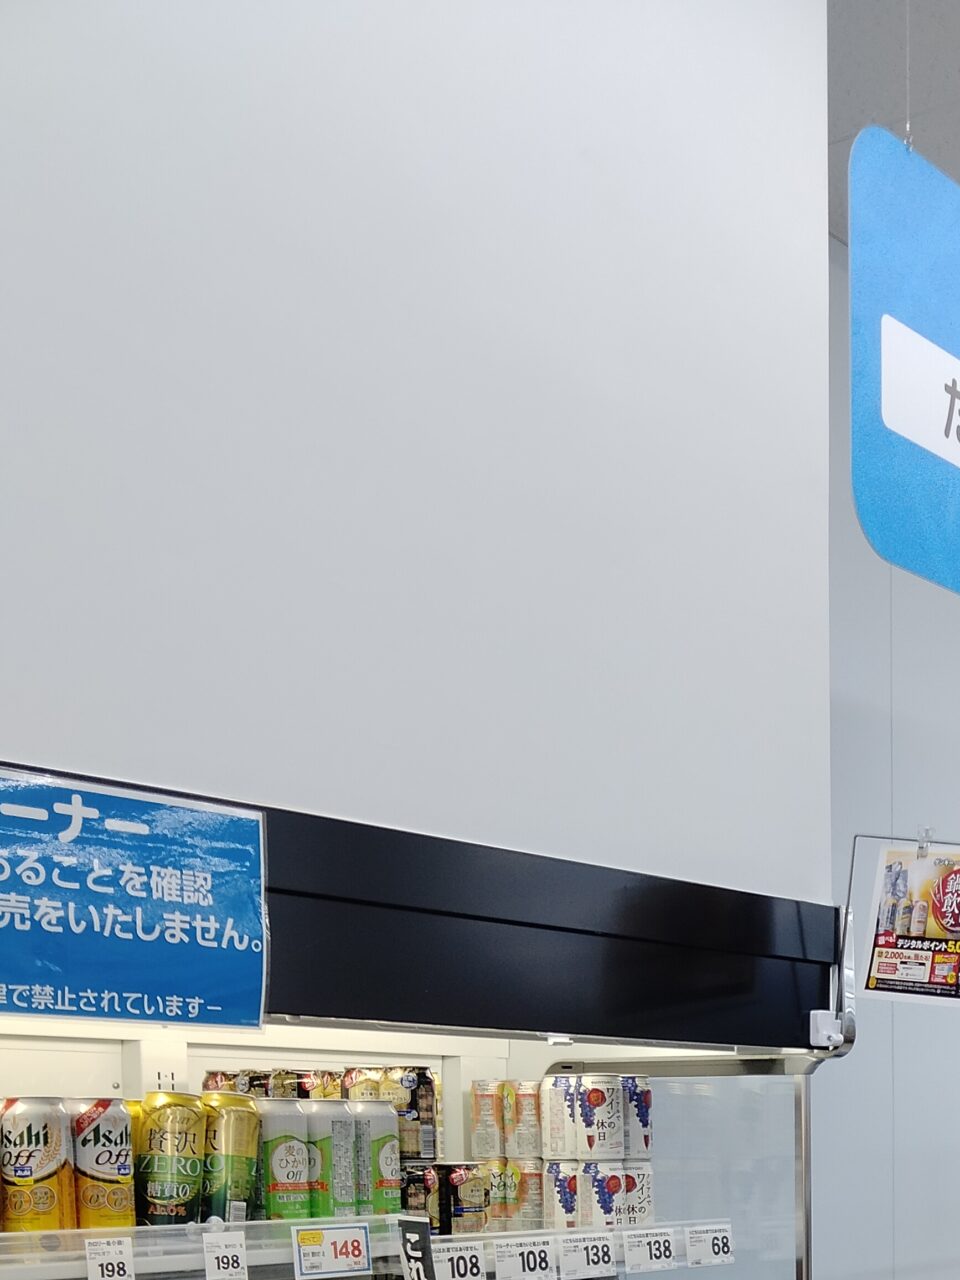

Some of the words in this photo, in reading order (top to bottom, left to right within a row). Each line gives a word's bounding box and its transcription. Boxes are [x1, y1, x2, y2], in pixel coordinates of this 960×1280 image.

[140, 1154, 201, 1177] ZERO
[330, 1239, 363, 1261] 148
[583, 1243, 611, 1266] 138
[646, 1239, 673, 1260] 138
[711, 1235, 731, 1256] 68
[98, 1260, 128, 1279] 198
[215, 1254, 241, 1270] 198
[447, 1254, 481, 1279] 108
[519, 1249, 549, 1273] 108
